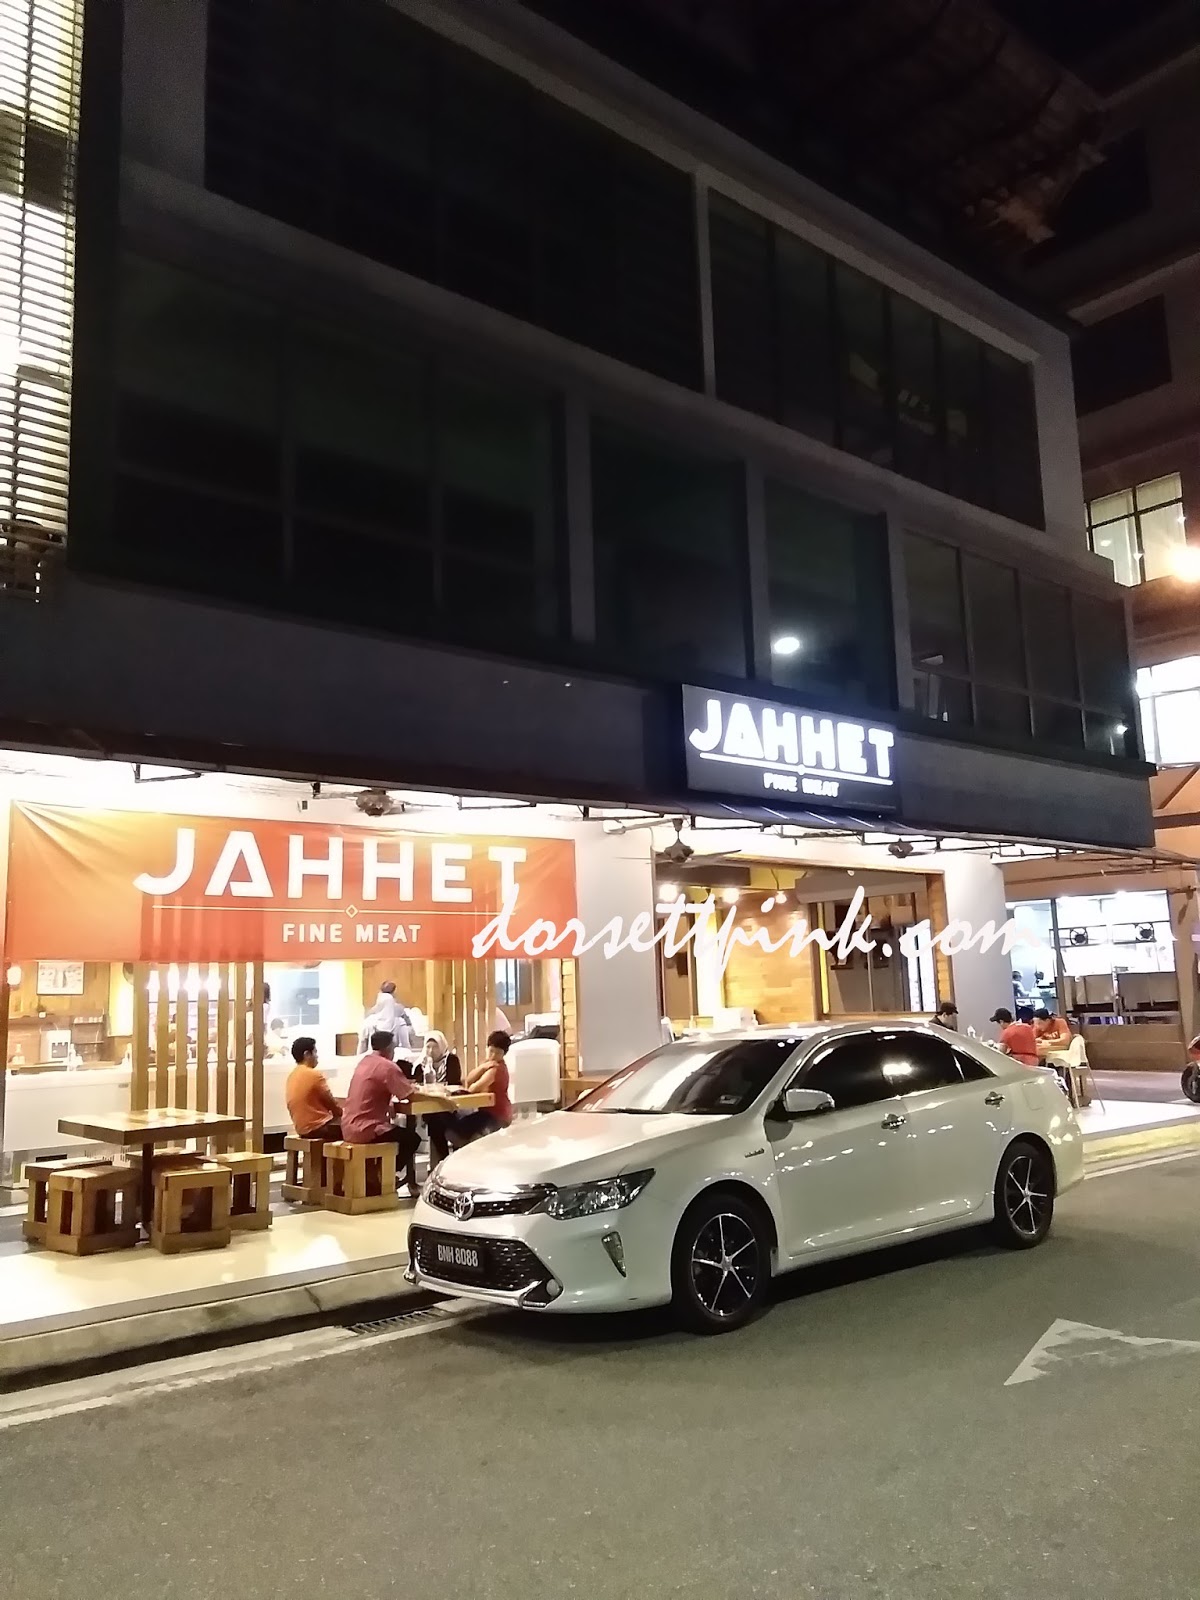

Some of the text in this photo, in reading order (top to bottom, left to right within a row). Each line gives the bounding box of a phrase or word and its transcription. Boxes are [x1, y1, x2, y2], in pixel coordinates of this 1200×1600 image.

[689, 699, 894, 778] JAHHET
[763, 772, 840, 798] FINE MEAT
[132, 828, 527, 903] JAHHET
[282, 923, 421, 943] FINE MEAT
[455, 1247, 479, 1267] 8088
